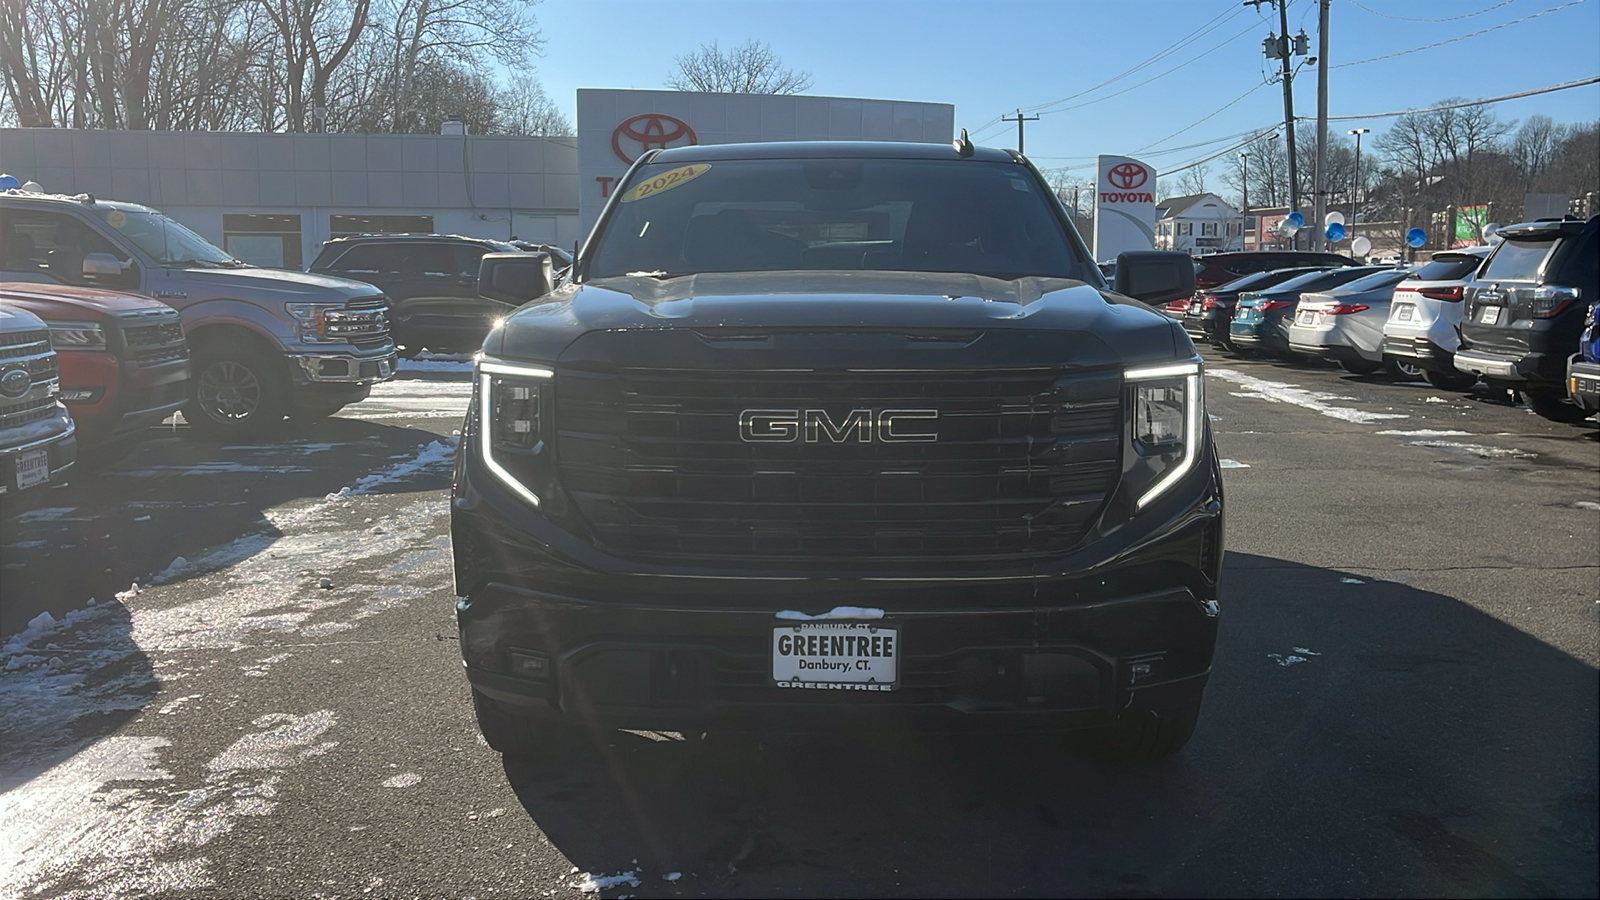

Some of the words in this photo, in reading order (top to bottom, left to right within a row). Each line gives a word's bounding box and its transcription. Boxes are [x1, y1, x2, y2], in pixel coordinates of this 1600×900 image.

[639, 166, 696, 197] 2024
[1100, 192, 1154, 203] TOYOTA
[739, 408, 938, 443] GMC
[778, 634, 893, 658] GREENTREE
[799, 659, 852, 673] Danbury,
[855, 660, 871, 671] CT.
[777, 681, 892, 692] GREENTREE
